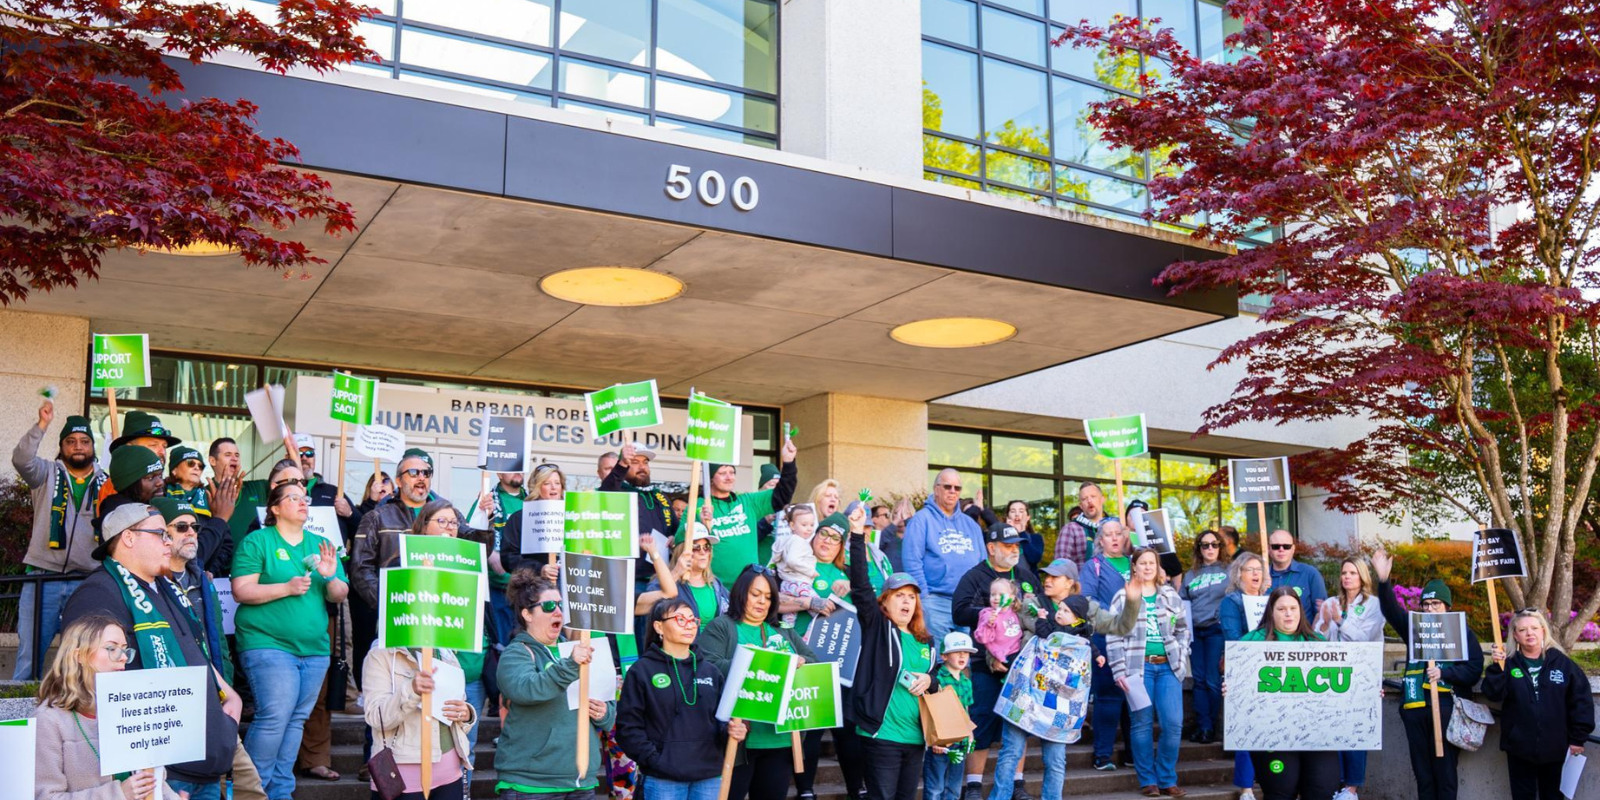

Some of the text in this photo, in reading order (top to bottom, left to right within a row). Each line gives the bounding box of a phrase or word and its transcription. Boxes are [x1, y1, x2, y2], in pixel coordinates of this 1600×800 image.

[664, 164, 759, 210] 500
[103, 339, 108, 350] I
[94, 353, 131, 364] UPPORT
[96, 368, 123, 379] SACU
[345, 378, 350, 388] I
[334, 402, 355, 416] SACU
[595, 401, 613, 412] Help
[629, 395, 648, 404] floor
[600, 412, 618, 423] with
[601, 511, 625, 520] floor
[410, 552, 476, 566] Help the floor
[568, 567, 602, 579] YOU SAY
[566, 584, 604, 596] YOU CARE
[391, 590, 470, 606] Help the floor
[569, 601, 616, 614] WHAT'S FAIR!
[393, 613, 464, 629] with the 3.4!
[816, 620, 829, 648] YOU SAY
[827, 622, 841, 655] YOU CARE
[150, 634, 167, 668] AFSCM
[1264, 652, 1347, 662] WE SUPPORT
[756, 669, 781, 683] floor
[1258, 666, 1353, 693] SACU
[108, 687, 194, 702] False vacancy rates,
[789, 686, 819, 702] PORT
[121, 703, 178, 718] lives at stake.
[786, 706, 809, 720] ACU
[116, 725, 142, 734] There
[143, 722, 150, 731] is
[163, 719, 183, 731] give,
[130, 735, 171, 749] only take!
